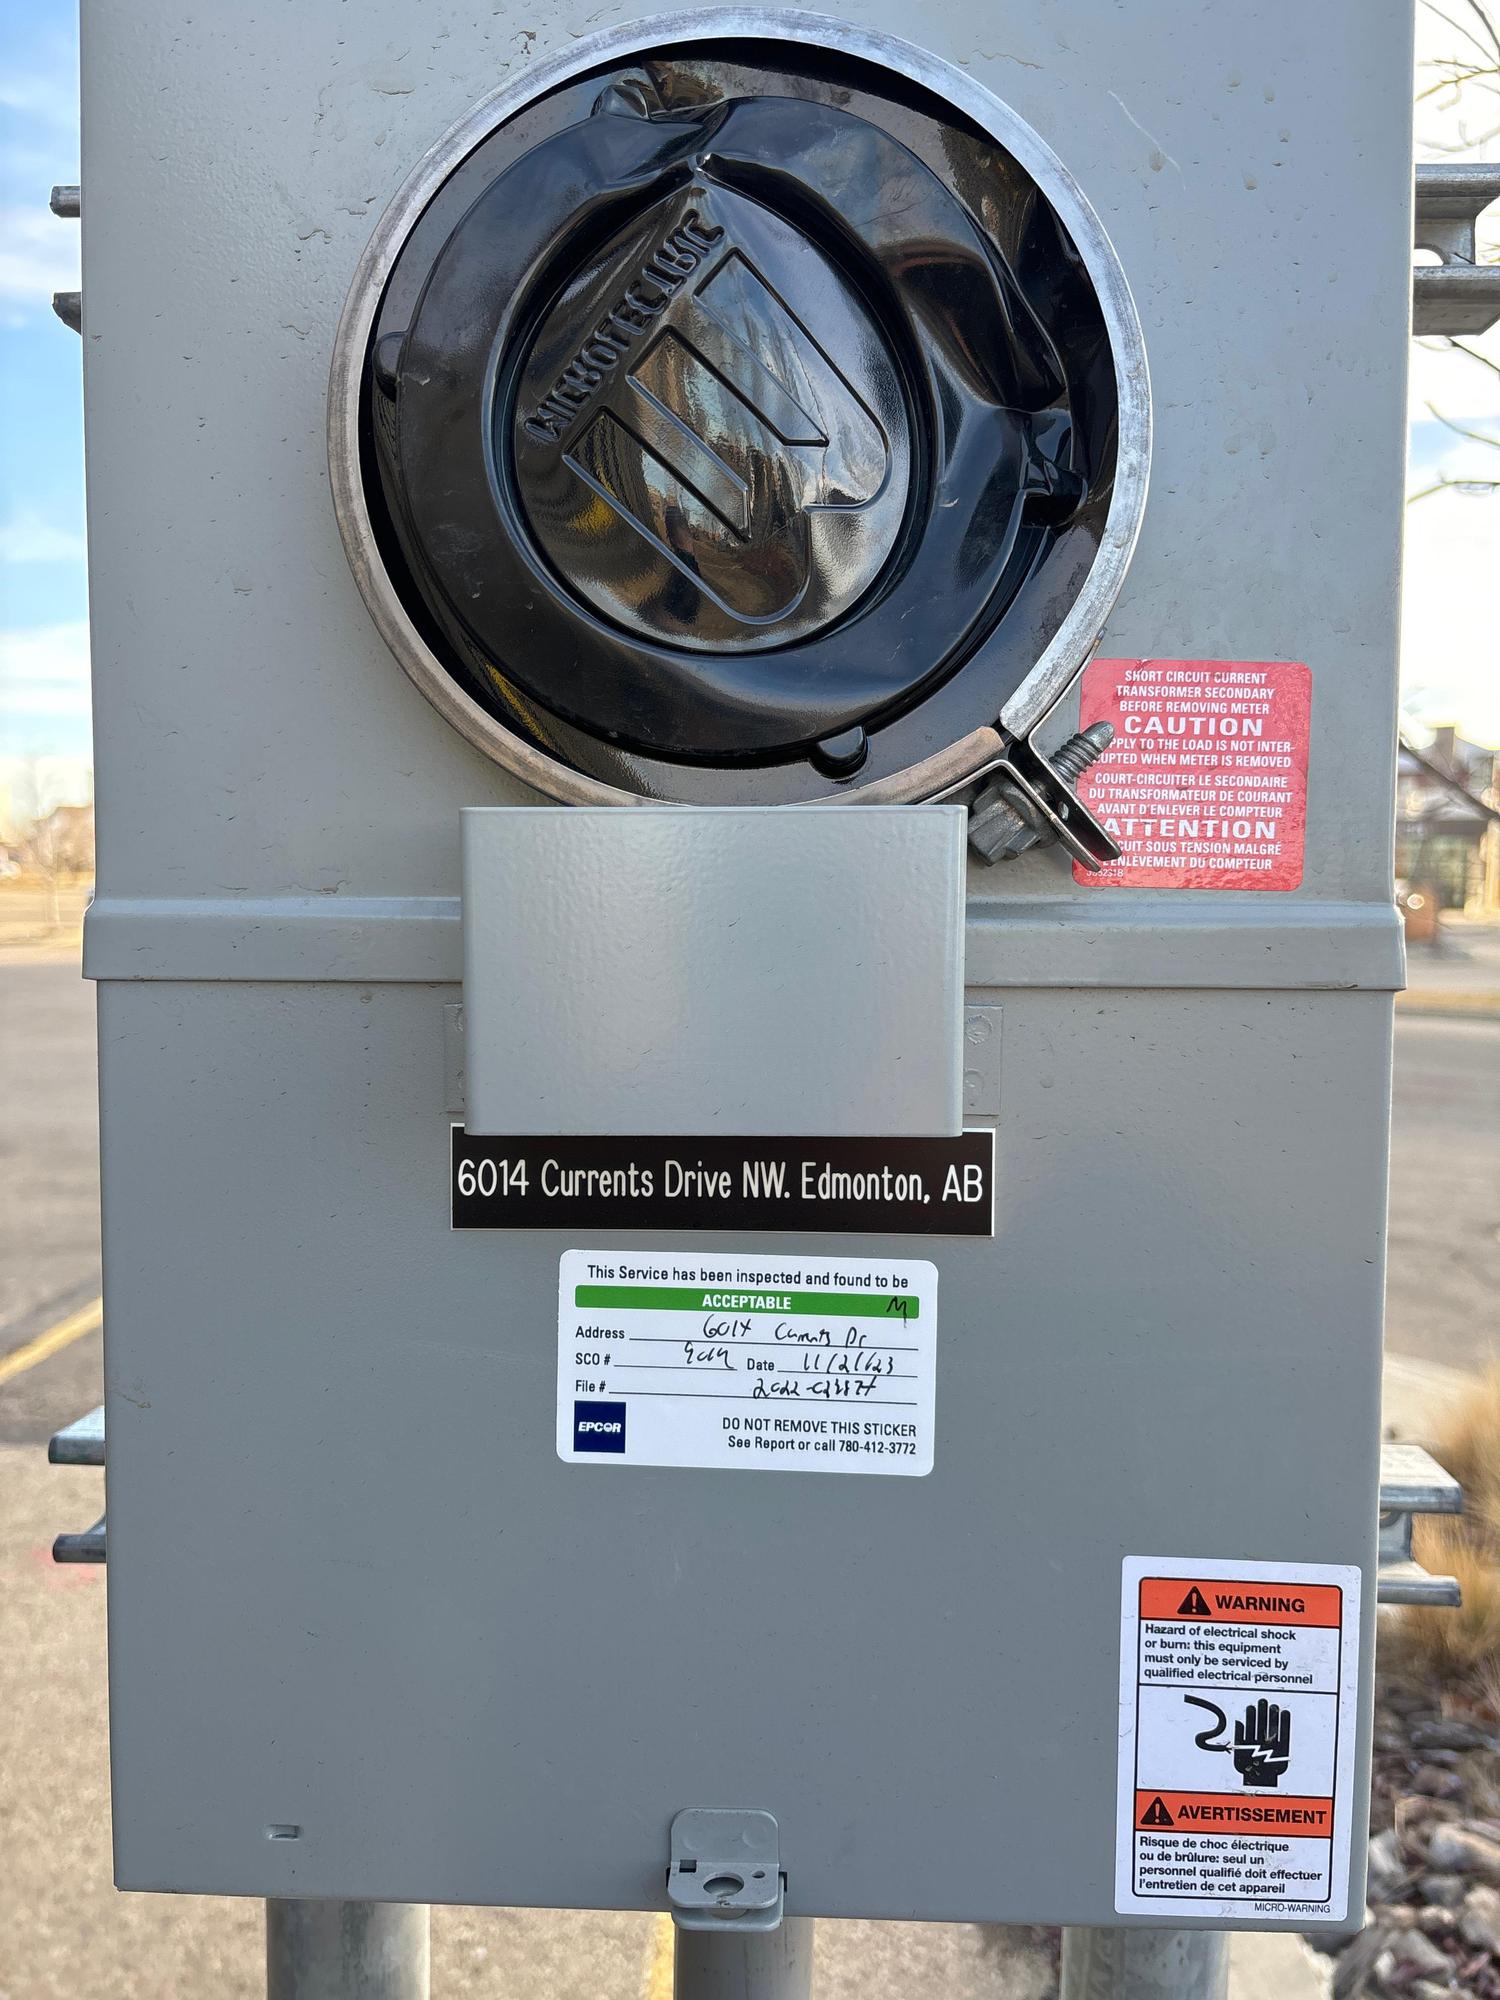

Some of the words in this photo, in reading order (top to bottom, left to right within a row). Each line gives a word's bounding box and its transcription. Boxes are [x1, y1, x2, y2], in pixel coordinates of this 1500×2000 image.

[1125, 669, 1163, 681] SHORT
[1166, 671, 1210, 682] CIRCUIT
[1214, 672, 1267, 684] CURRENT
[1116, 685, 1201, 697] TRANSFORMER
[1205, 687, 1275, 699] SECONDARY
[1120, 701, 1162, 712] BEFORE
[1167, 702, 1227, 713] REMOVING
[1231, 703, 1269, 714] METER
[1125, 716, 1262, 736] CAUTION
[1110, 739, 1135, 749] PPLY
[1140, 739, 1154, 750] TO
[1158, 739, 1179, 750] THE
[1183, 739, 1212, 751] LOAD
[1216, 740, 1227, 751] IS
[1231, 741, 1253, 752] NOT
[1258, 741, 1295, 752] INTER-
[1094, 753, 1137, 764] UPTED
[1141, 754, 1176, 765] WHEN
[1180, 755, 1218, 765] METER
[1222, 755, 1232, 766] IS
[1236, 756, 1291, 767] REMOVED
[1096, 773, 1195, 785] COURT-CIRCUITER
[1199, 775, 1211, 785] LE
[1215, 776, 1287, 787] SECONDAIRE
[1089, 788, 1105, 798] DU
[1108, 788, 1216, 801] TRANSFORMATEUR
[1220, 791, 1234, 801] DE
[1238, 791, 1292, 802] COURANT
[1097, 803, 1136, 814] AVANT
[1139, 804, 1200, 815] D'ENLEVER
[1204, 806, 1215, 816] LE
[1220, 806, 1282, 817] COMPTEUR
[1103, 818, 1275, 839] ATTENTION
[1118, 841, 1143, 852] CUIT
[1146, 841, 1177, 853] SOUS
[1181, 842, 1234, 854] TENSION
[1234, 841, 1281, 855] MALGRÉ
[1190, 857, 1205, 868] DU
[1210, 858, 1272, 870] COMPTEUR
[458, 1158, 529, 1196] 6014
[541, 1159, 654, 1197] Currents
[665, 1160, 731, 1199] Drive
[743, 1161, 791, 1199] NW.
[801, 1162, 930, 1204] Edmonton,
[942, 1164, 983, 1202] AB
[588, 1265, 614, 1278] This
[619, 1266, 668, 1280] Service
[673, 1267, 695, 1280] has
[701, 1268, 731, 1281] been
[737, 1269, 800, 1285] inspected
[806, 1272, 829, 1285] and
[834, 1273, 870, 1286] found
[875, 1276, 887, 1287] to
[893, 1275, 908, 1288] be
[702, 1294, 791, 1309] ACCEPTABLE
[576, 1326, 624, 1339] Address
[576, 1353, 599, 1365] SCO
[604, 1354, 610, 1365] #
[748, 1358, 774, 1371] Date
[576, 1380, 595, 1392] File
[599, 1381, 606, 1392] #
[579, 1422, 621, 1432] EPCOR
[723, 1418, 739, 1429] DO
[745, 1418, 770, 1430] NOT
[775, 1419, 827, 1433] REMOVE
[831, 1422, 859, 1434] THIS
[864, 1423, 916, 1436] STICKER
[729, 1435, 750, 1448] See
[755, 1437, 794, 1451] Report
[798, 1441, 810, 1450] or
[815, 1440, 835, 1451] call
[839, 1440, 915, 1454] 780-412-3772
[1216, 1595, 1304, 1612] WARNING
[1146, 1624, 1185, 1635] Hazard
[1189, 1626, 1200, 1635] of
[1204, 1627, 1257, 1638] electrical
[1261, 1629, 1296, 1640] shock
[1160, 1639, 1190, 1649] burn:
[1194, 1640, 1215, 1650] this
[1219, 1642, 1281, 1654] equipment
[1145, 1654, 1173, 1663] must
[1177, 1655, 1201, 1666] only
[1204, 1655, 1218, 1665] be
[1222, 1657, 1271, 1667] serviced
[1275, 1658, 1288, 1670] by
[1144, 1668, 1194, 1680] qualified
[1198, 1670, 1251, 1681] electrical
[1254, 1673, 1312, 1684] personnel
[1178, 1806, 1326, 1824] AVERTISSEMENT
[1140, 1836, 1179, 1849] Risque
[1183, 1838, 1196, 1848] de
[1200, 1839, 1227, 1849] choc
[1231, 1840, 1289, 1853] électrique
[1157, 1851, 1171, 1861] de
[1175, 1852, 1219, 1863] brûlure:
[1223, 1855, 1246, 1864] seul
[1140, 1867, 1196, 1876] personnel
[1200, 1868, 1241, 1878] qualifié
[1245, 1869, 1267, 1878] doit
[1270, 1870, 1322, 1880] effectuer
[1140, 1879, 1197, 1890] l'entretien
[1200, 1881, 1214, 1891] de
[1218, 1882, 1236, 1891] cet
[1239, 1884, 1285, 1894] appareil
[1255, 1903, 1330, 1913] MICRO-WARNING
